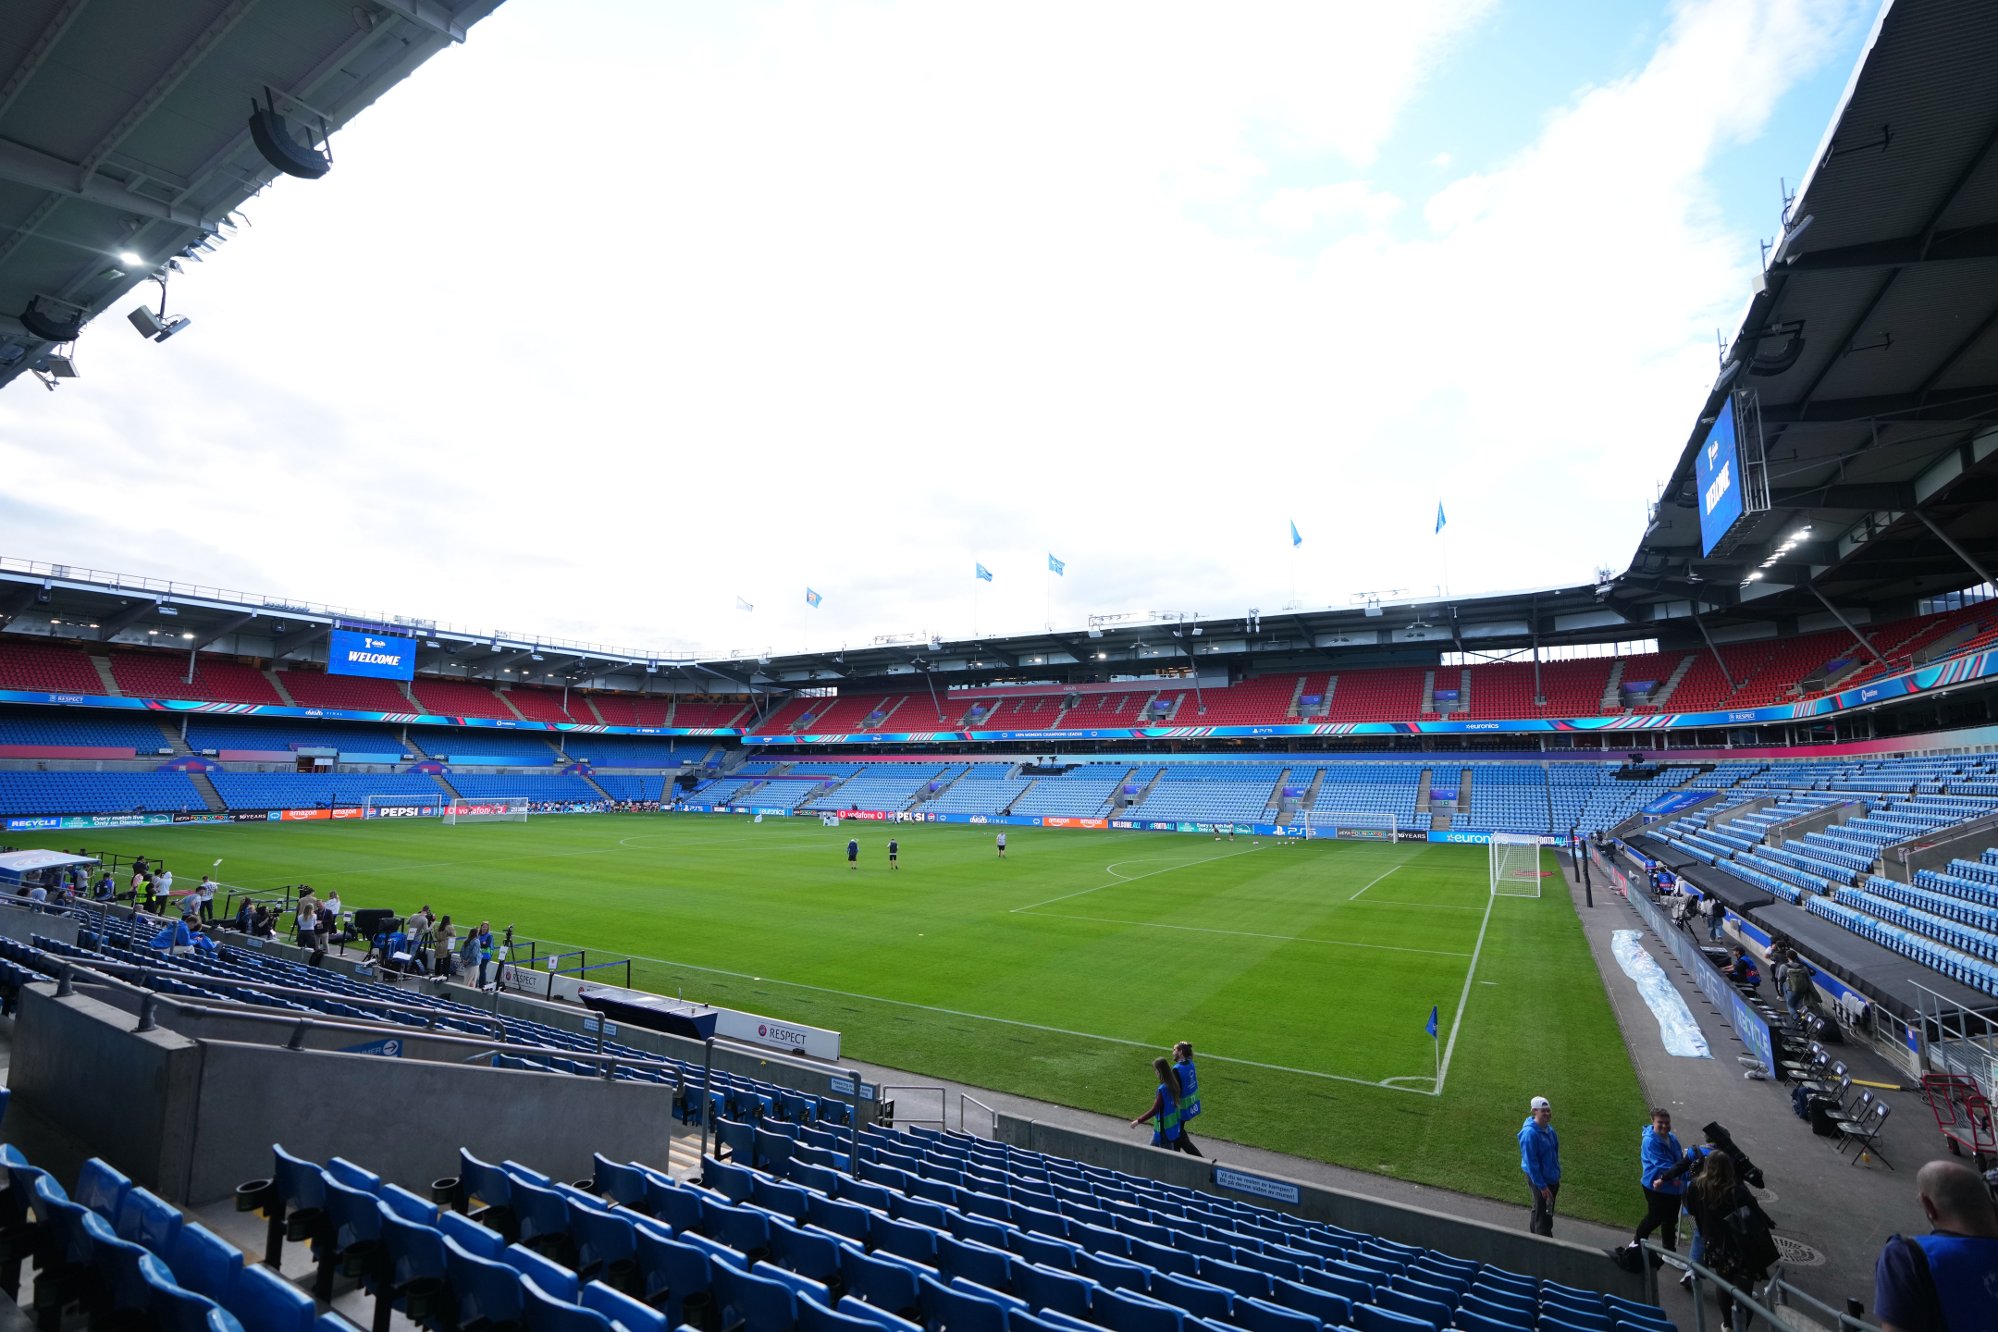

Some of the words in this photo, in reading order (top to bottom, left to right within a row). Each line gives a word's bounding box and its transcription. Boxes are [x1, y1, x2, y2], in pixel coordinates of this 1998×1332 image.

[348, 651, 401, 666] WELCOME
[380, 807, 418, 817] PEPSI
[848, 811, 875, 819] vodafone
[1288, 828, 1317, 836] PS5
[513, 973, 536, 986] RSPECT
[769, 1027, 807, 1045] RESPECT
[1736, 1006, 1769, 1057] RECYCLE
[1228, 1179, 1235, 1187] på
[1235, 1181, 1252, 1189] denne
[1252, 1184, 1267, 1193] siden
[1275, 1192, 1295, 1200] muren!
[1243, 1177, 1261, 1186] resten
[1268, 1183, 1294, 1194] kampen?
